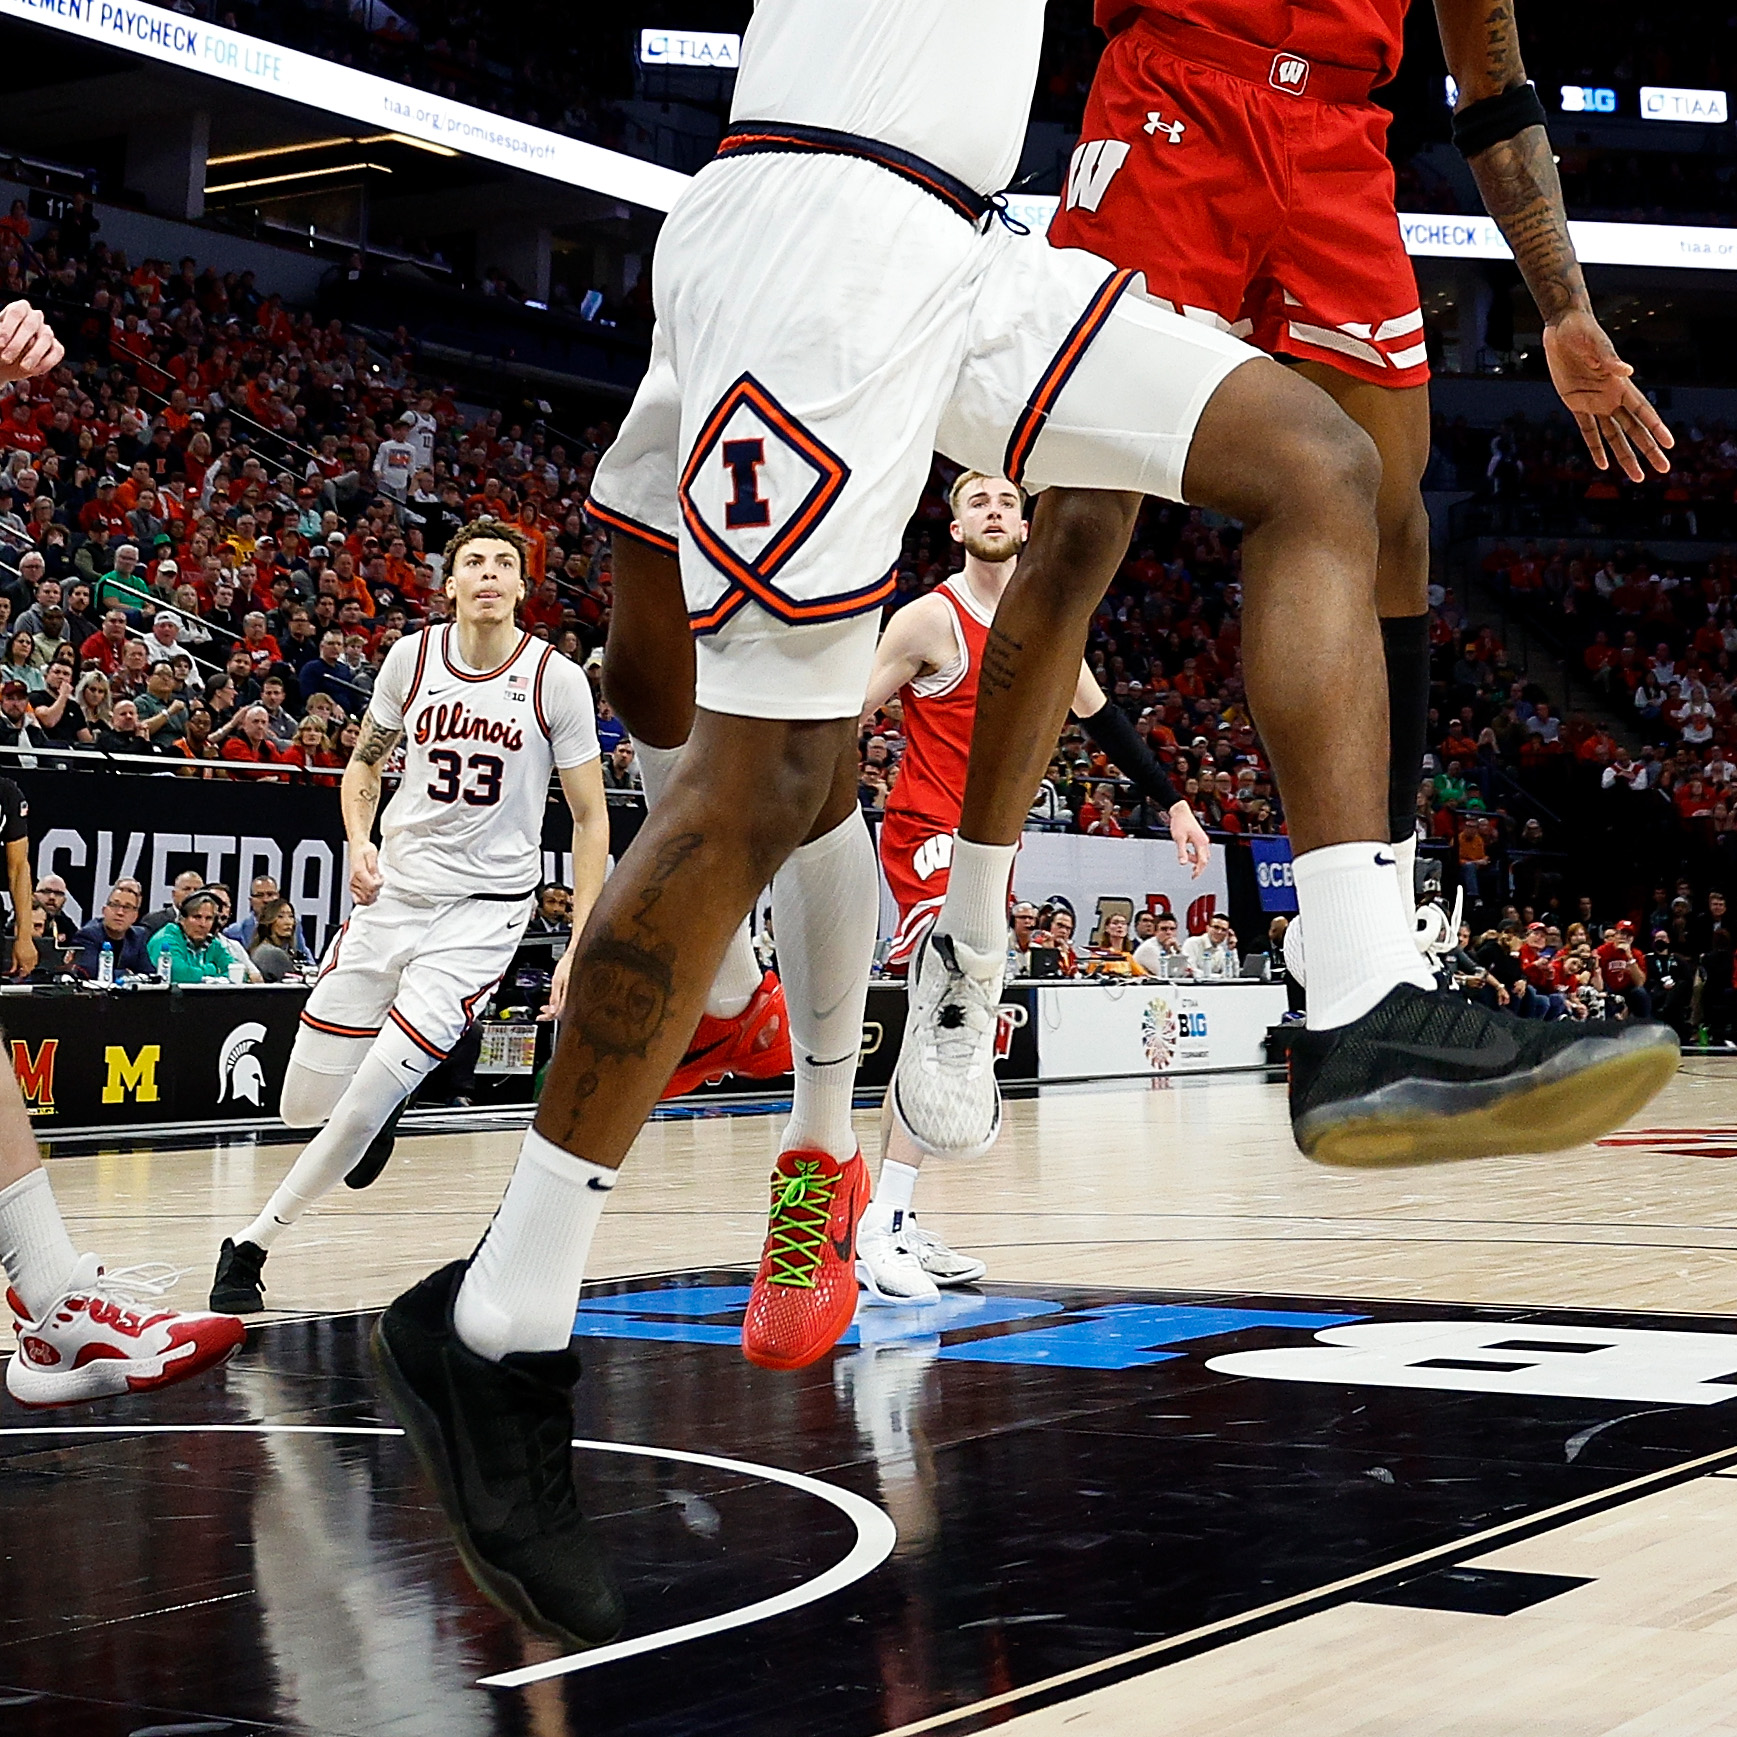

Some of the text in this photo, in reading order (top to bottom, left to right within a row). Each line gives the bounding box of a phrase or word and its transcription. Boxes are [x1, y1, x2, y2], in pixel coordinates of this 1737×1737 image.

[100, 2, 199, 56] PAYCHECK
[203, 35, 239, 67] FOR
[677, 38, 734, 62] TIAA
[383, 95, 557, 160] tiaa.org/promisespayoff
[1671, 95, 1723, 117] TIAA
[1402, 224, 1477, 247] YCHECK
[720, 436, 771, 532] I
[414, 701, 524, 752] Illinois
[426, 748, 505, 807] 33
[102, 1044, 161, 1105] M
